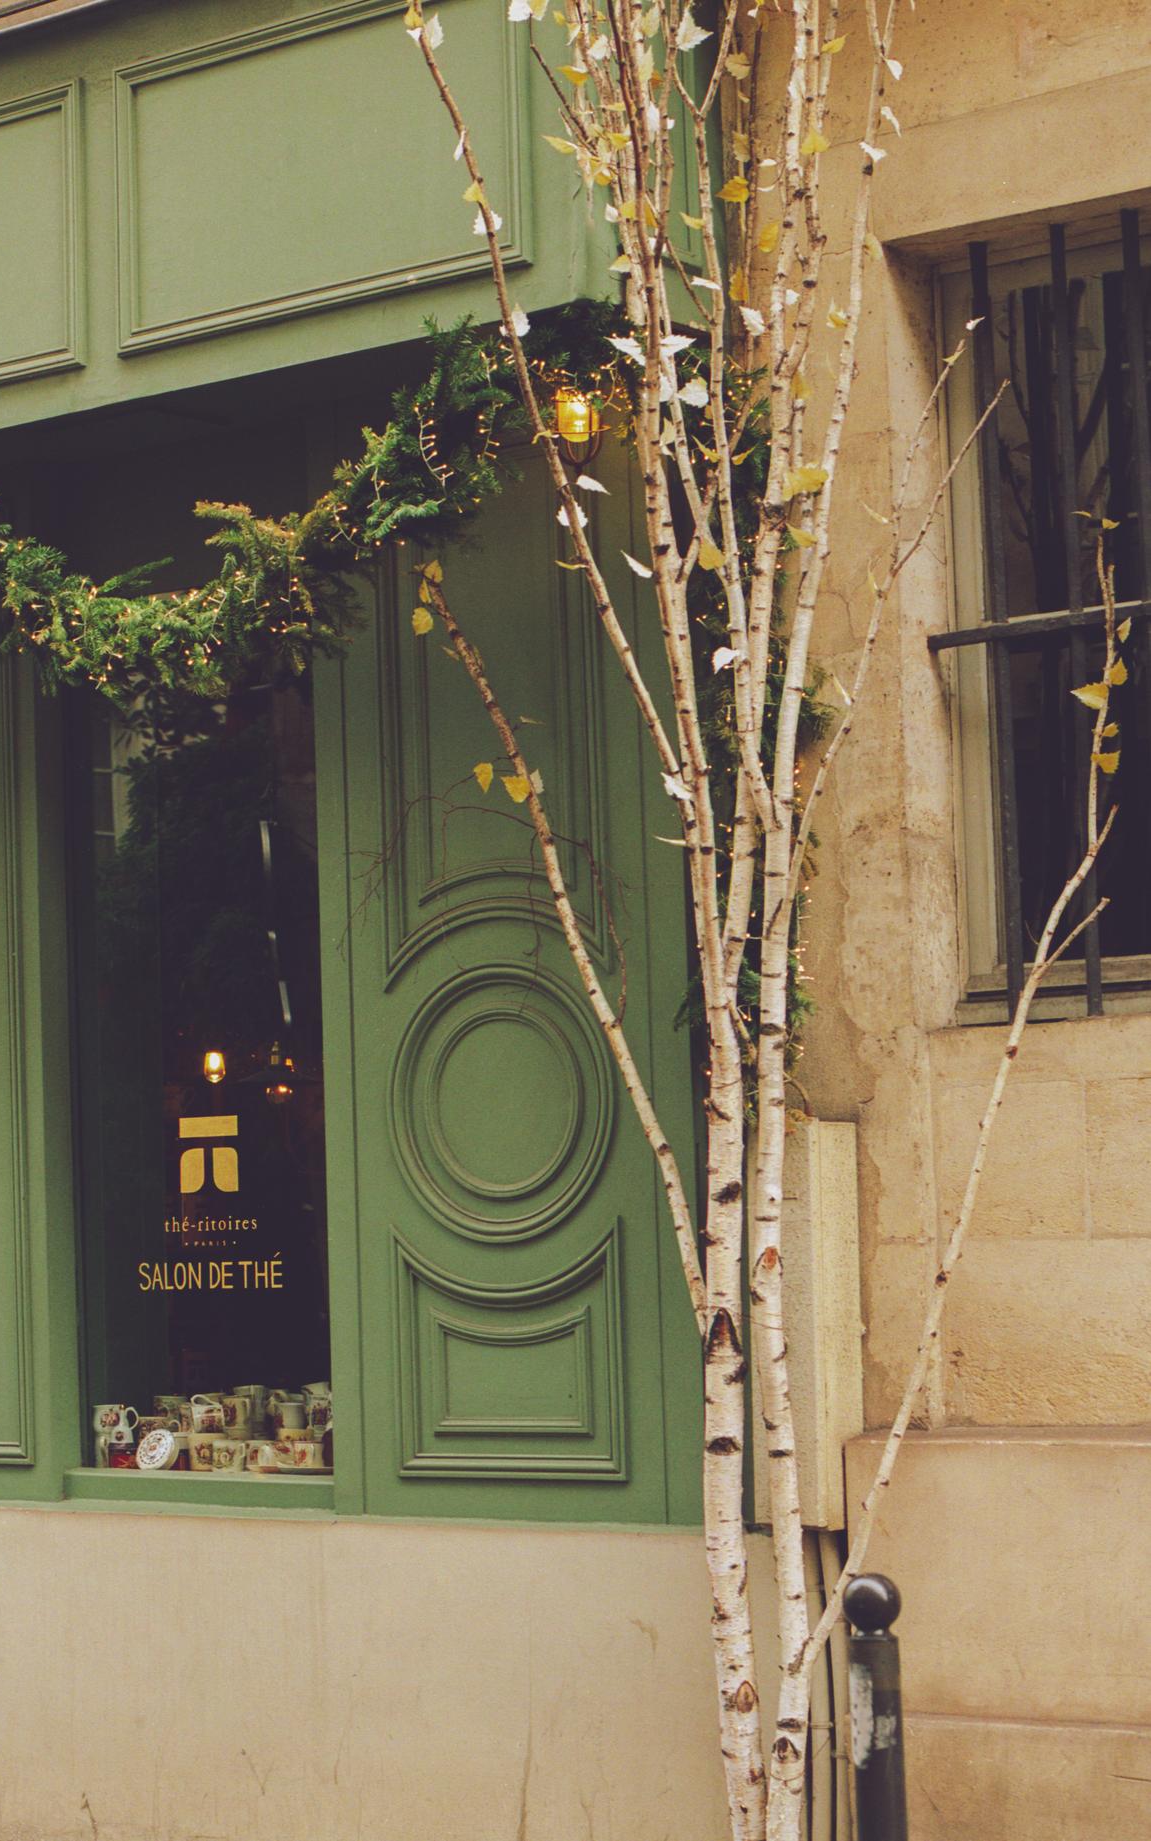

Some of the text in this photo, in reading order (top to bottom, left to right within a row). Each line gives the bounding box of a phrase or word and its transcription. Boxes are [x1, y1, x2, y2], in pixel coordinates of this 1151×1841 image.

[164, 1215, 258, 1233] thé-ritoires
[138, 1251, 284, 1291] SALON DE THÉ
